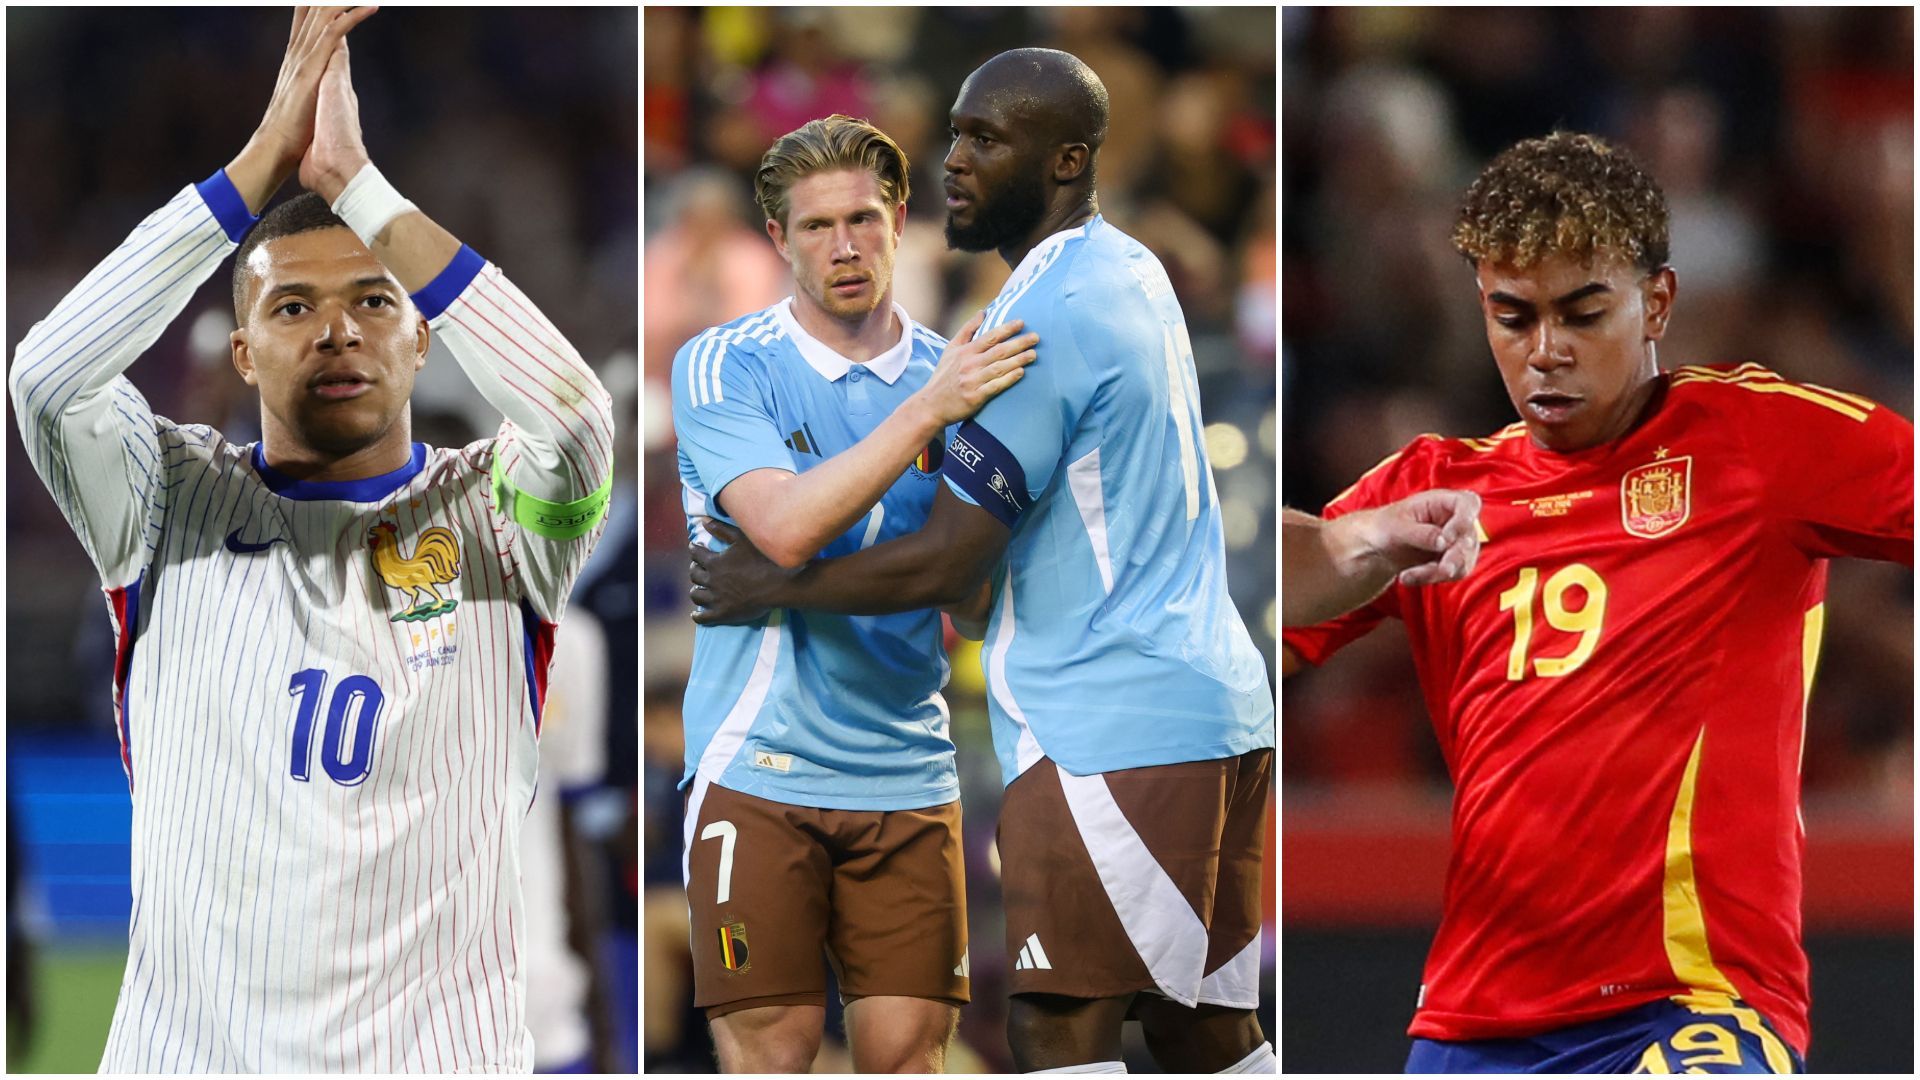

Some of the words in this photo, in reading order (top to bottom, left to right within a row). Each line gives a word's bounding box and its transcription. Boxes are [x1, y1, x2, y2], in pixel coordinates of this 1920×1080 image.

[406, 649, 431, 666] FRANCE
[1500, 563, 1608, 681] 19
[288, 668, 385, 787] 10
[701, 820, 737, 904] 7
